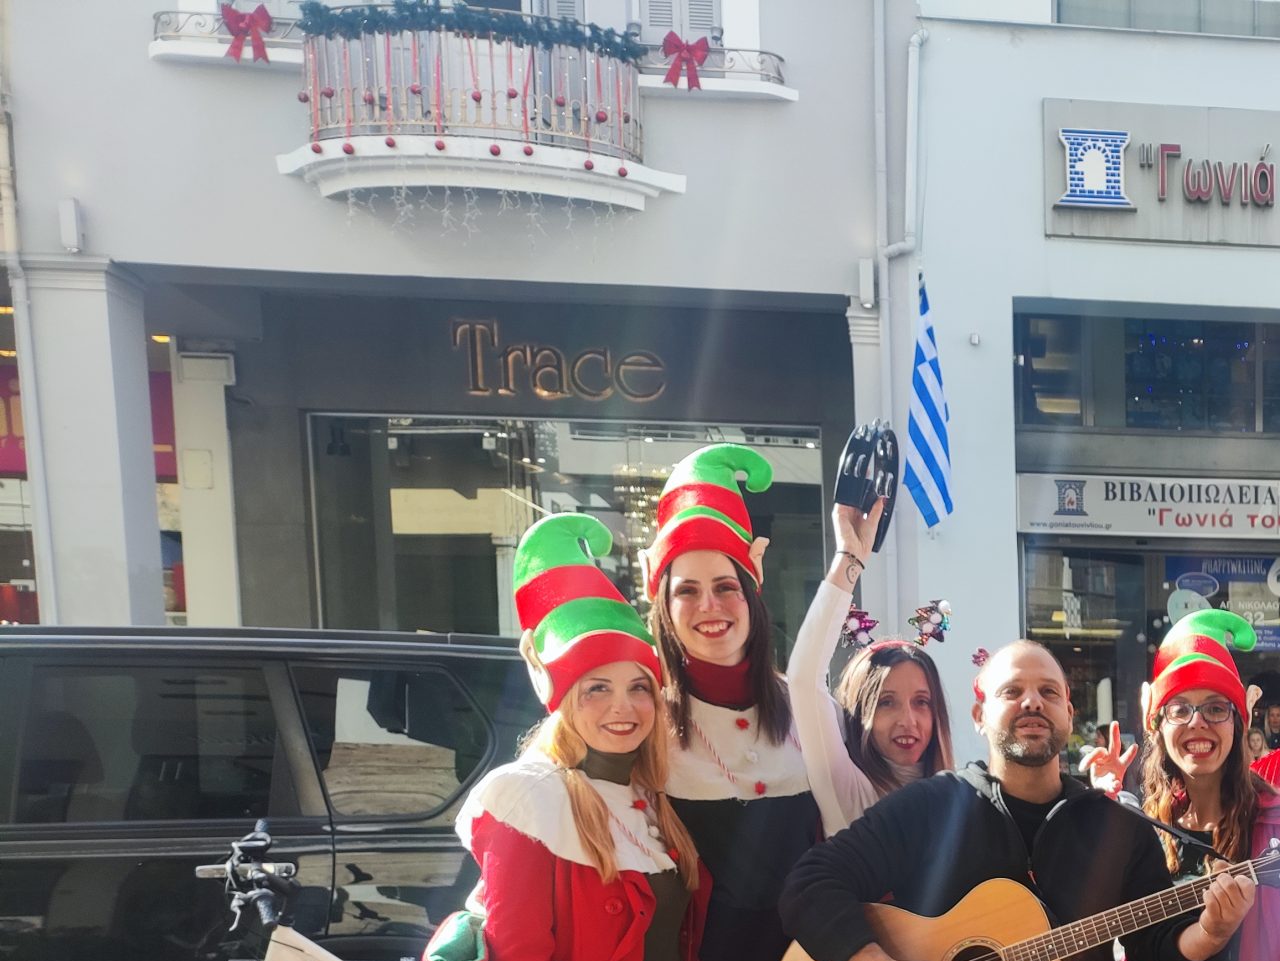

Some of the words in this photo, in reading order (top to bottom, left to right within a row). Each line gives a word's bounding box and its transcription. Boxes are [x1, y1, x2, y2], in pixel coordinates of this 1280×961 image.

[1139, 142, 1276, 208] "Γωνιά
[452, 318, 666, 402] Trace
[1103, 481, 1276, 506] ΒΙΒΛΙΟΠΩΛΕΙΑ
[1148, 507, 1234, 529] "Γωνιά
[1243, 611, 1265, 625] 32
